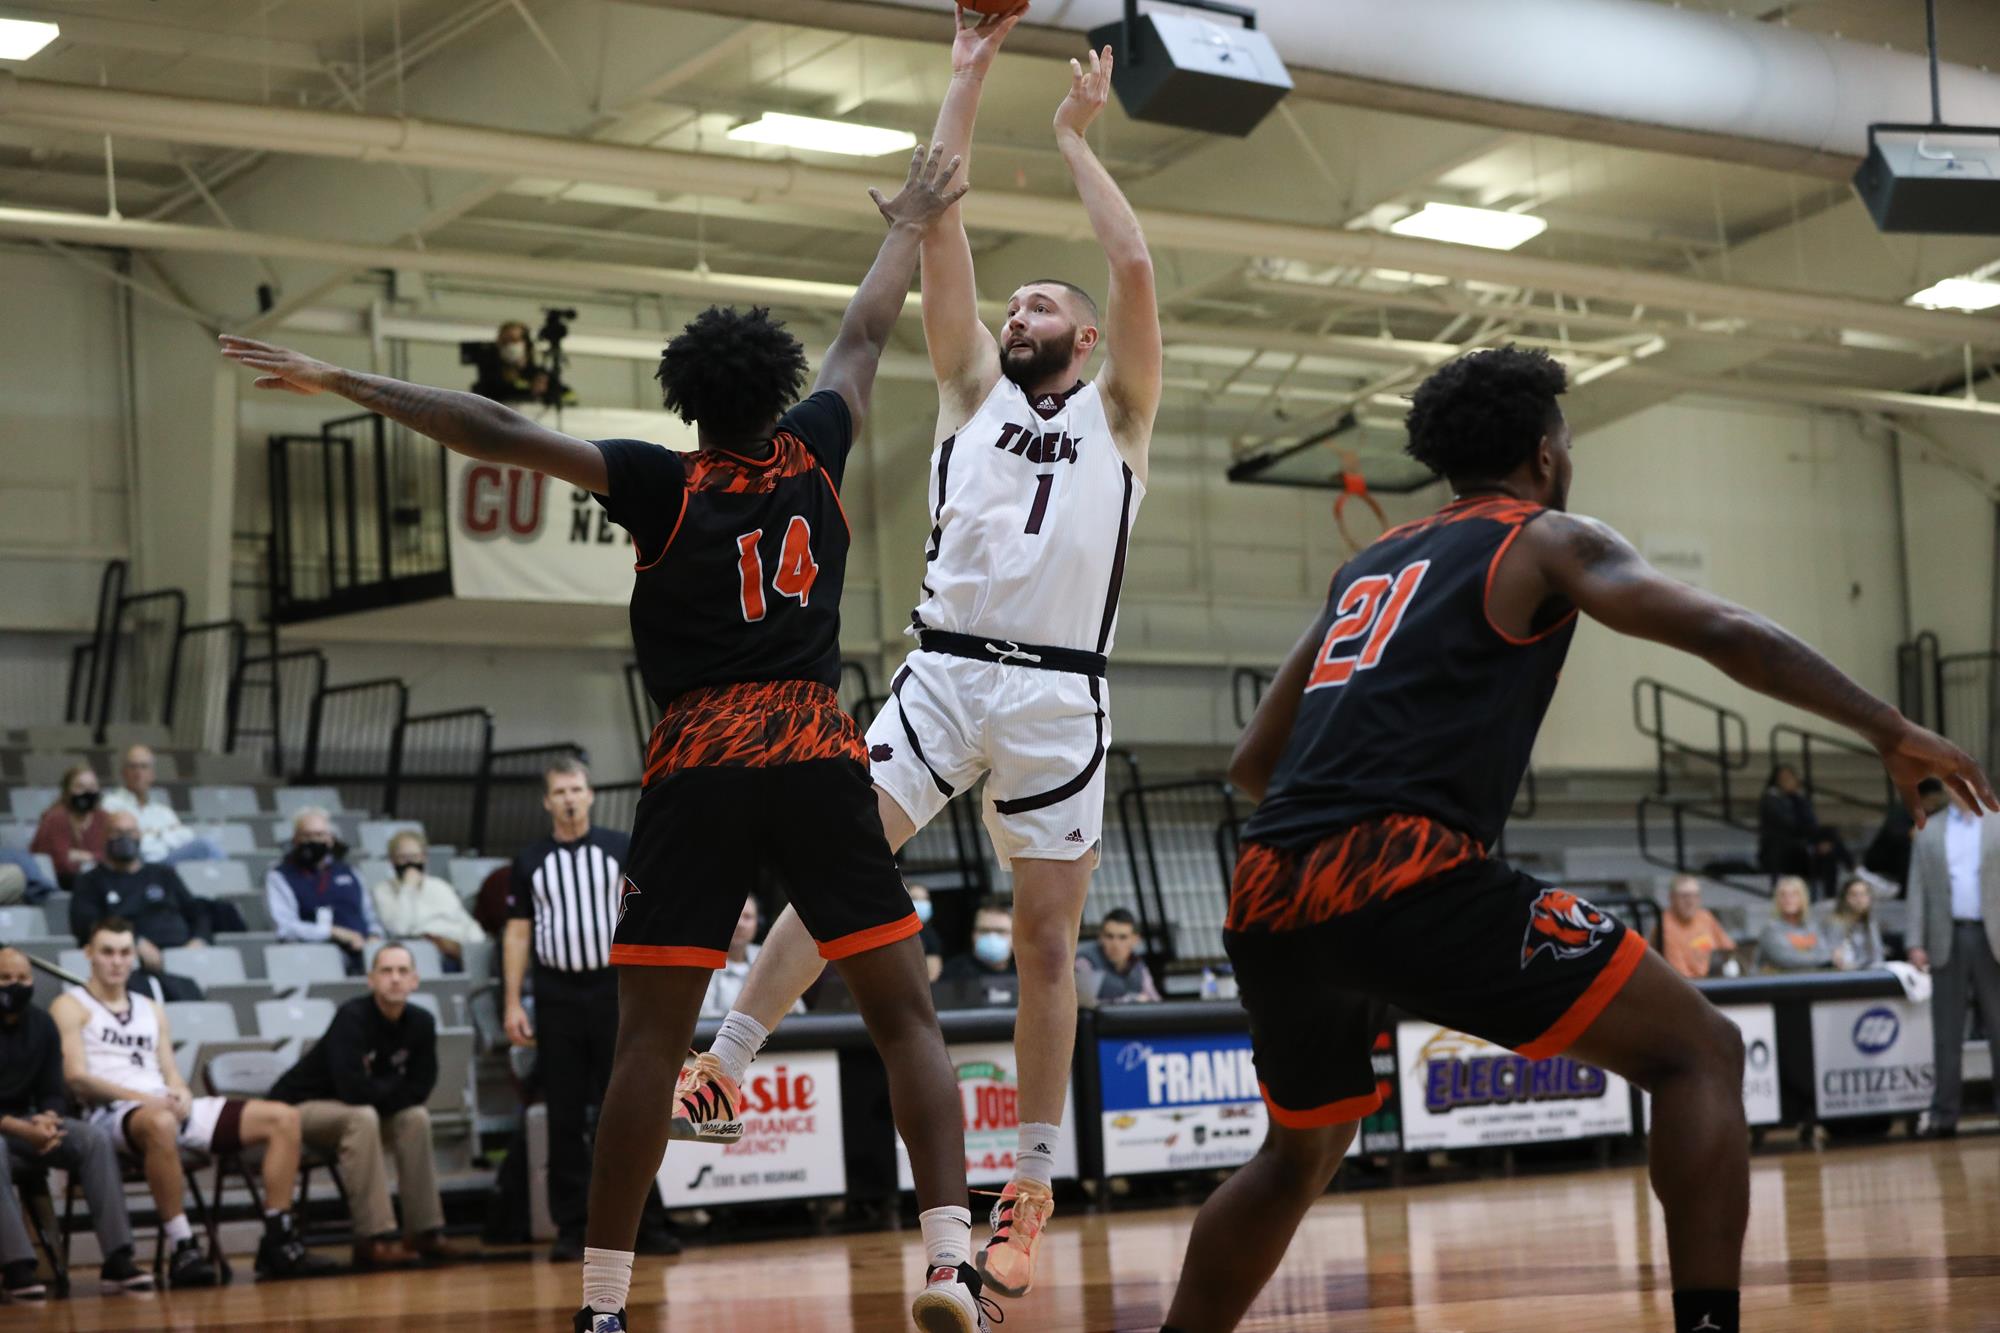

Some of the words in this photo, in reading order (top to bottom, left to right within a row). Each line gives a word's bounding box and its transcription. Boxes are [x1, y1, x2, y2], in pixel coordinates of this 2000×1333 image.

[463, 465, 547, 535] CU
[1023, 473, 1055, 536] 1
[736, 515, 820, 623] 14
[1303, 558, 1432, 695] 21
[1823, 1063, 1936, 1097] CITIZENS
